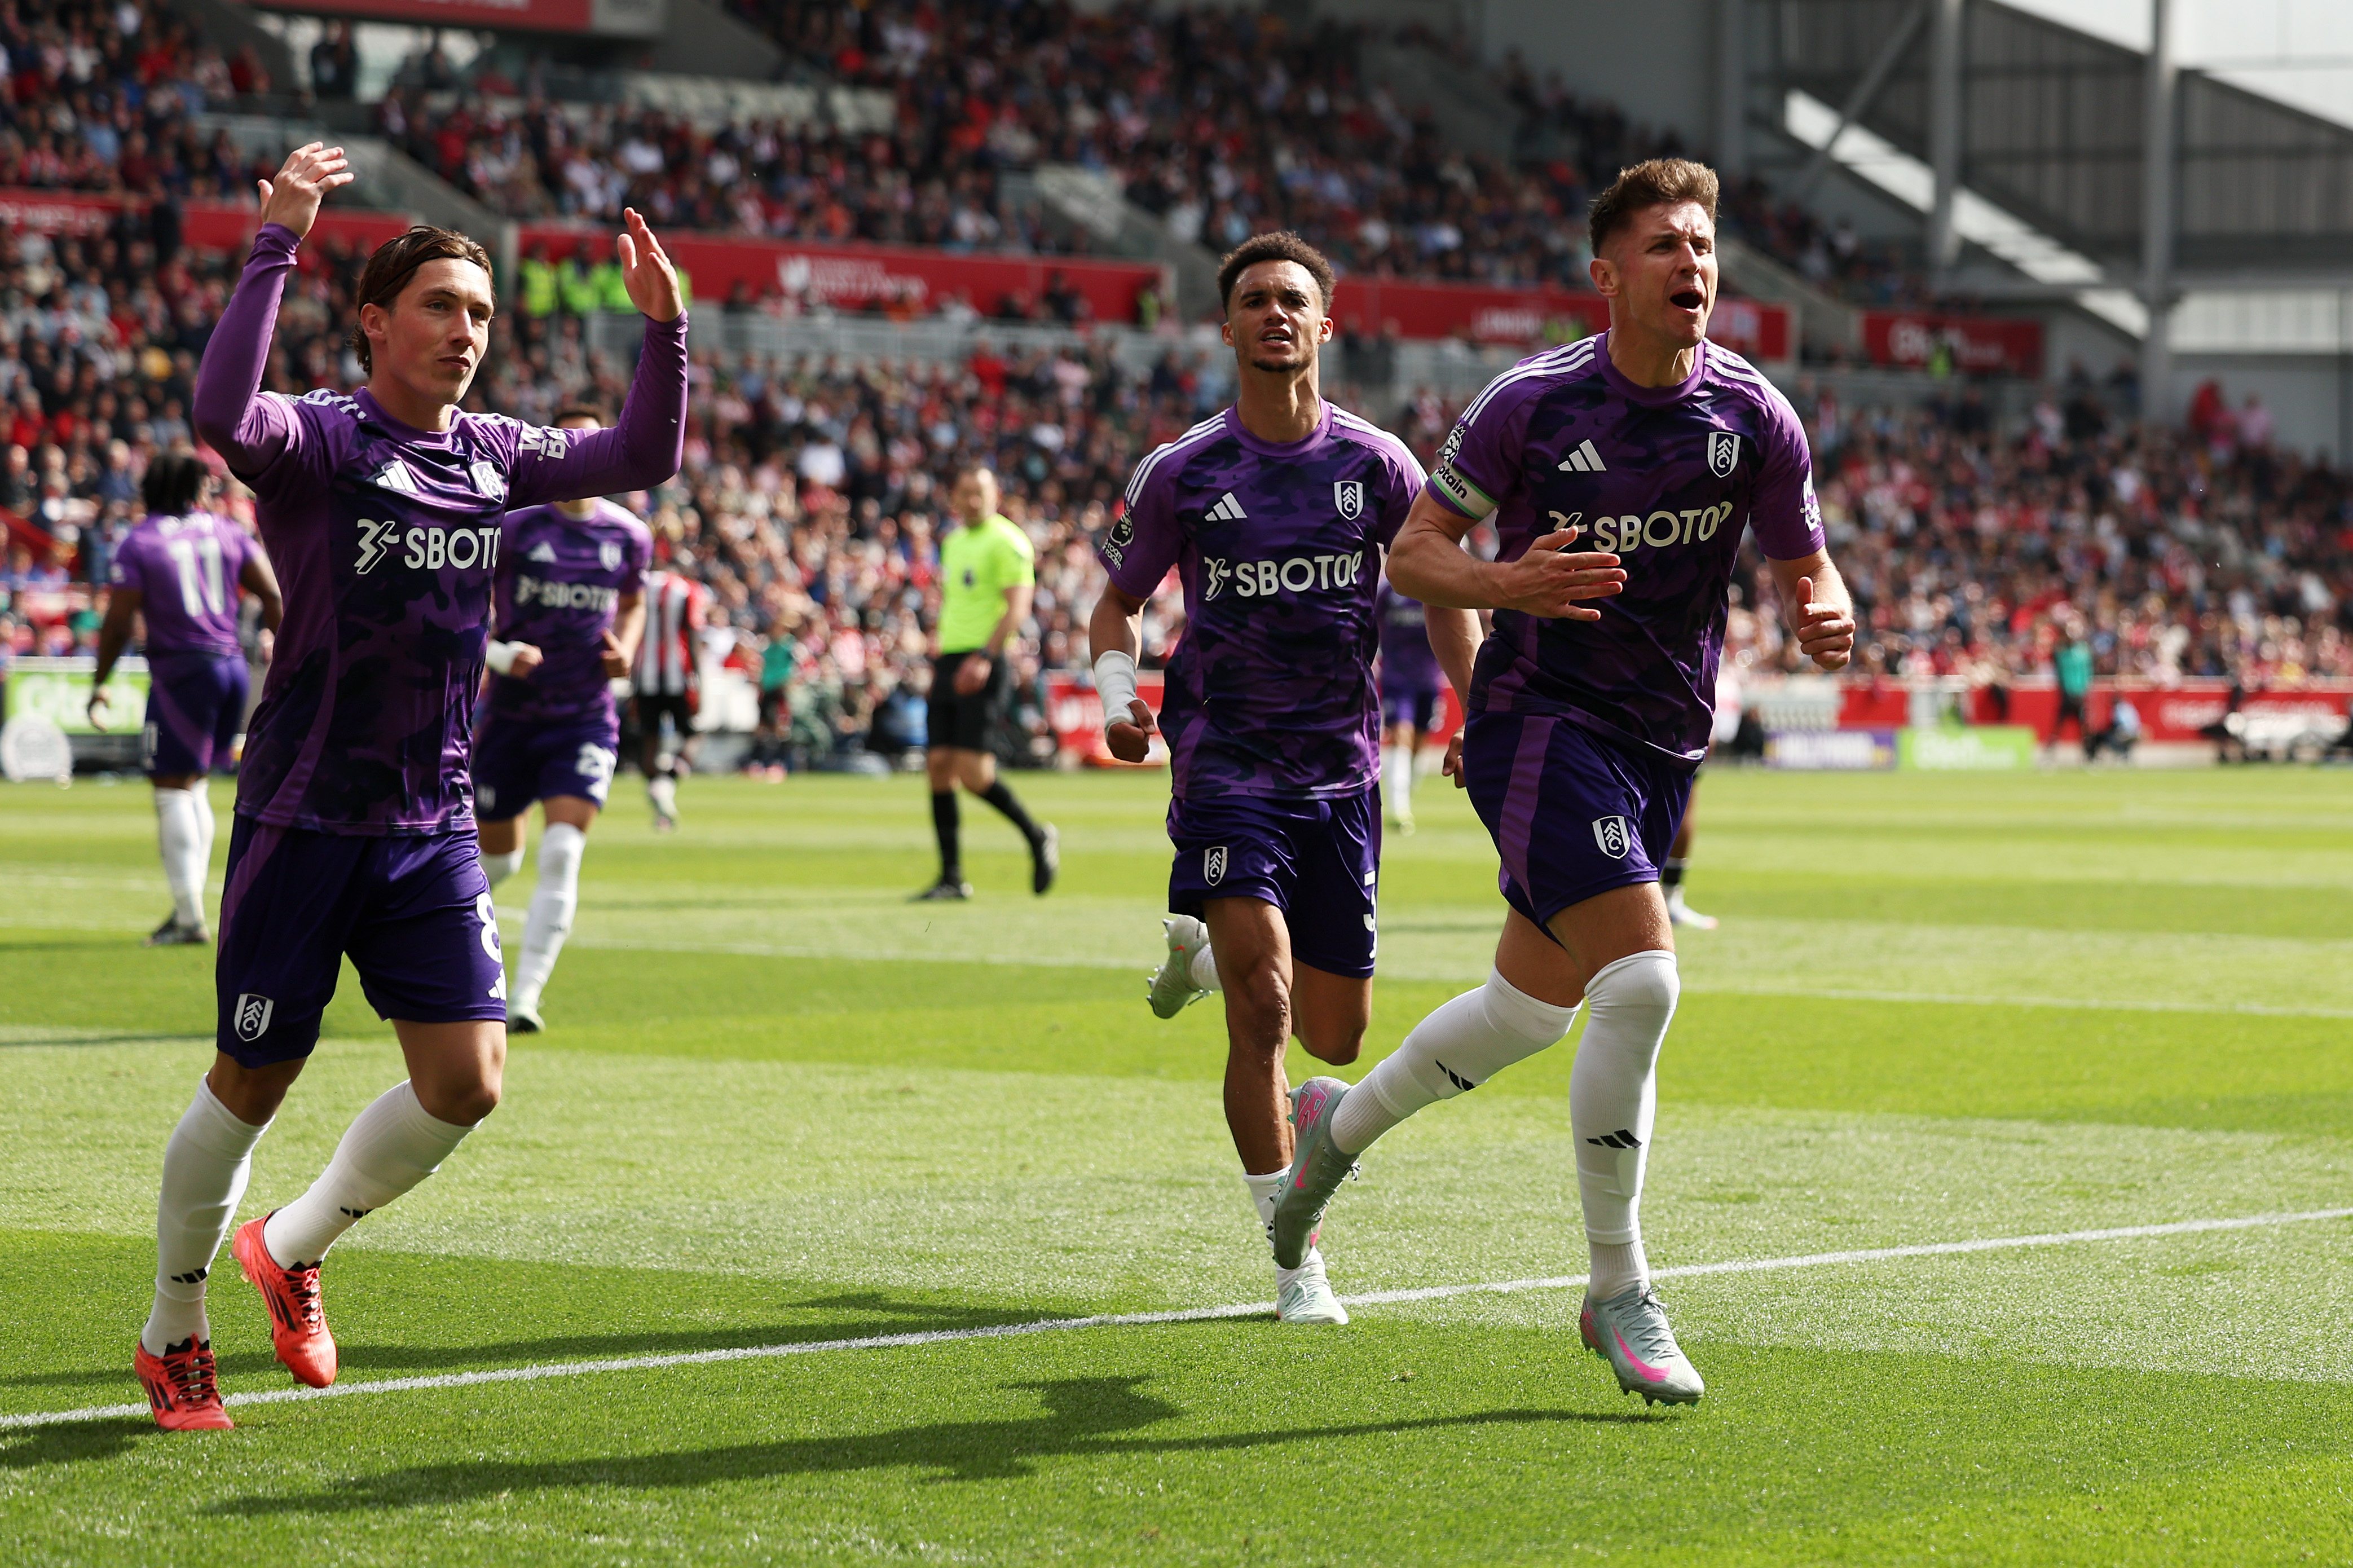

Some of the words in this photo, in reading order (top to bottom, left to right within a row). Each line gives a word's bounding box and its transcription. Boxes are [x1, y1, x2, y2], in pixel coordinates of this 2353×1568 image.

[1716, 438, 1733, 469] FFC
[1436, 464, 1468, 499] ptain
[1342, 485, 1356, 512] FFC
[169, 538, 226, 617] 11
[1236, 550, 1363, 597] SBOTOP
[1604, 821, 1622, 851] FFC
[1210, 851, 1222, 878] FFC
[243, 999, 264, 1032] FFC
